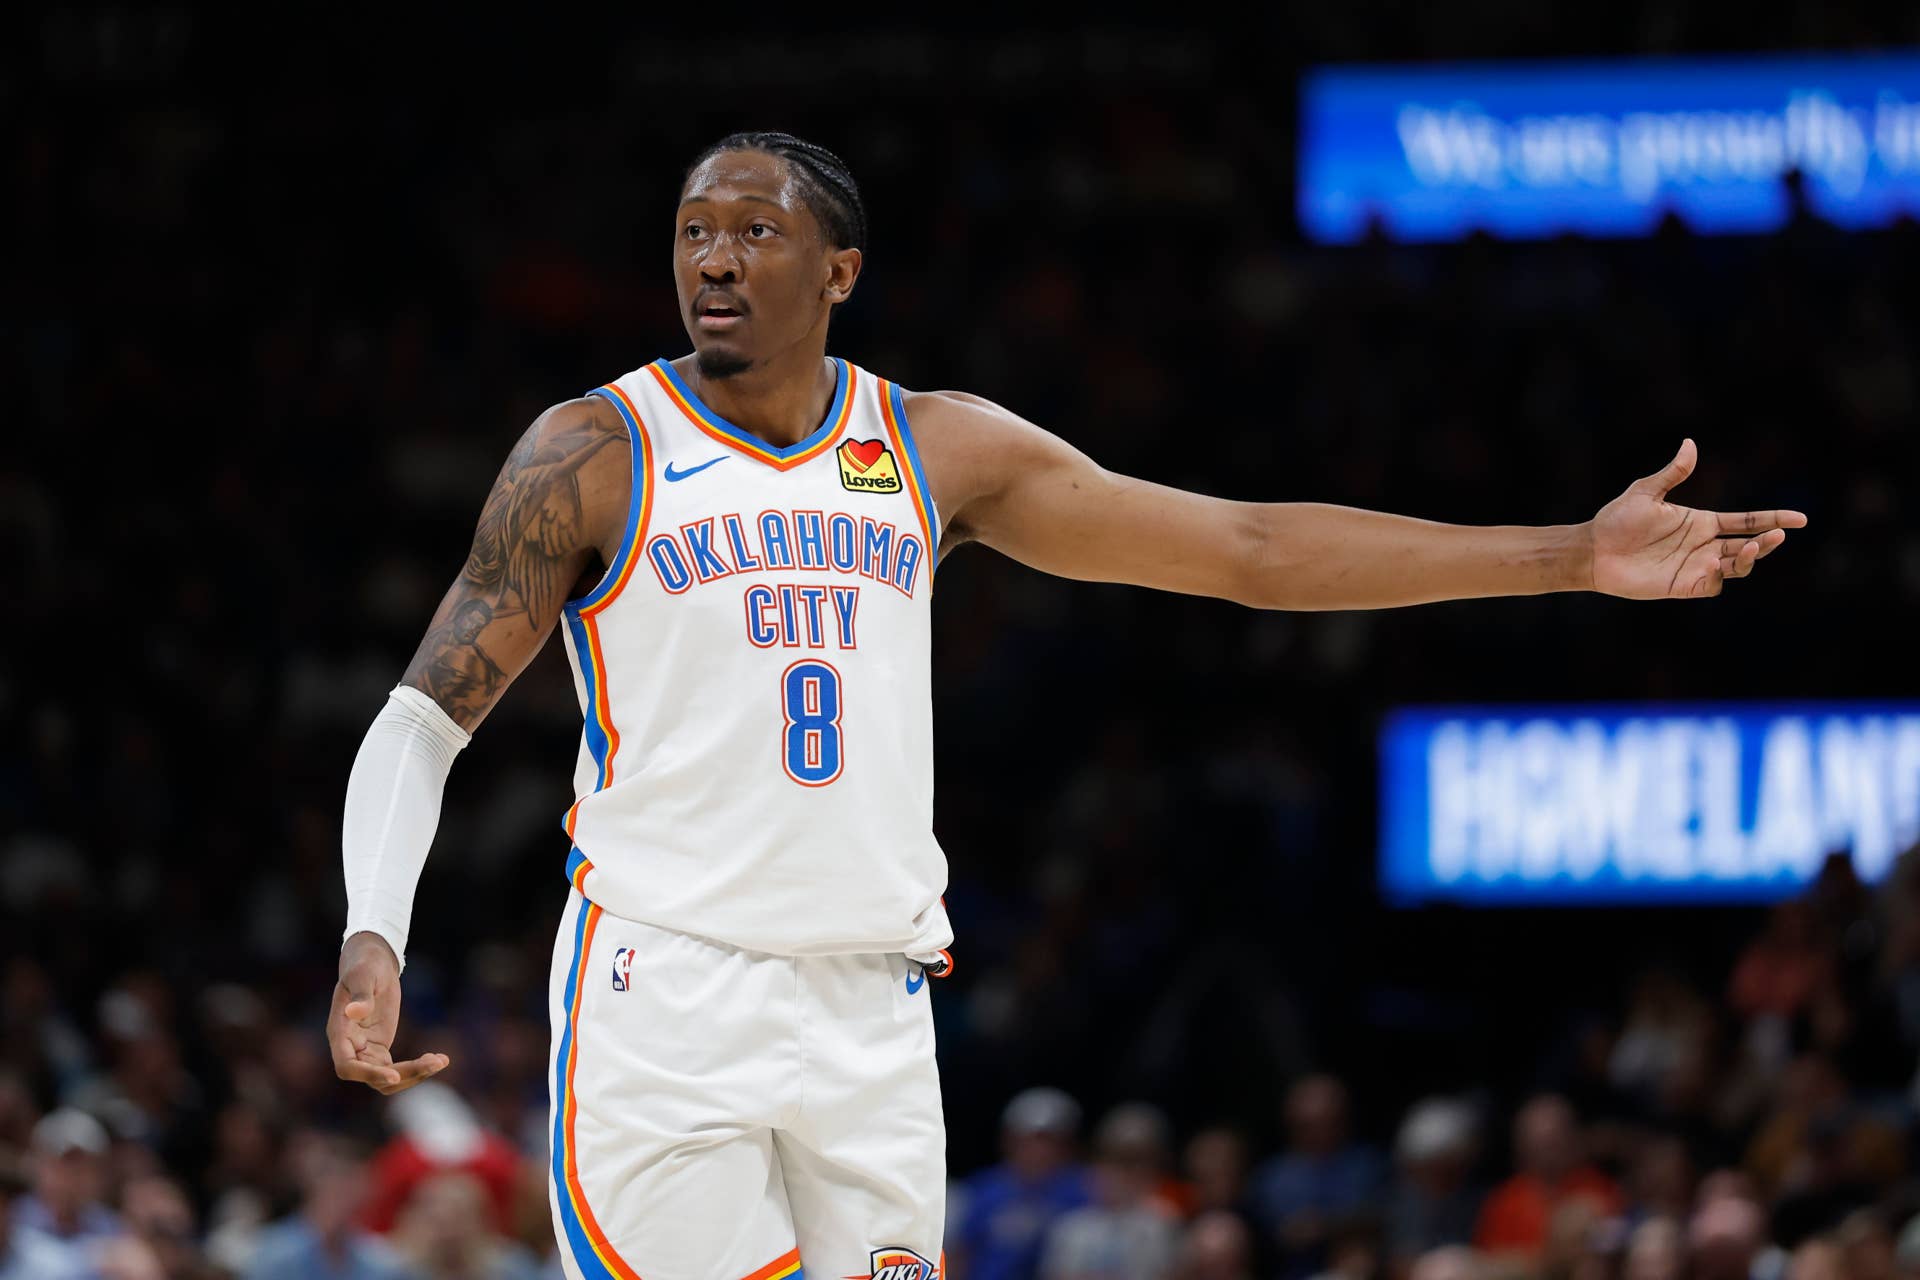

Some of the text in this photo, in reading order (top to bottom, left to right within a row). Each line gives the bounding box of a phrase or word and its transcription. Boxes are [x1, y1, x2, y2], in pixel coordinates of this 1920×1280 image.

[647, 510, 922, 599] OKLAHOMA
[745, 584, 859, 649] CITY
[782, 659, 844, 787] 8
